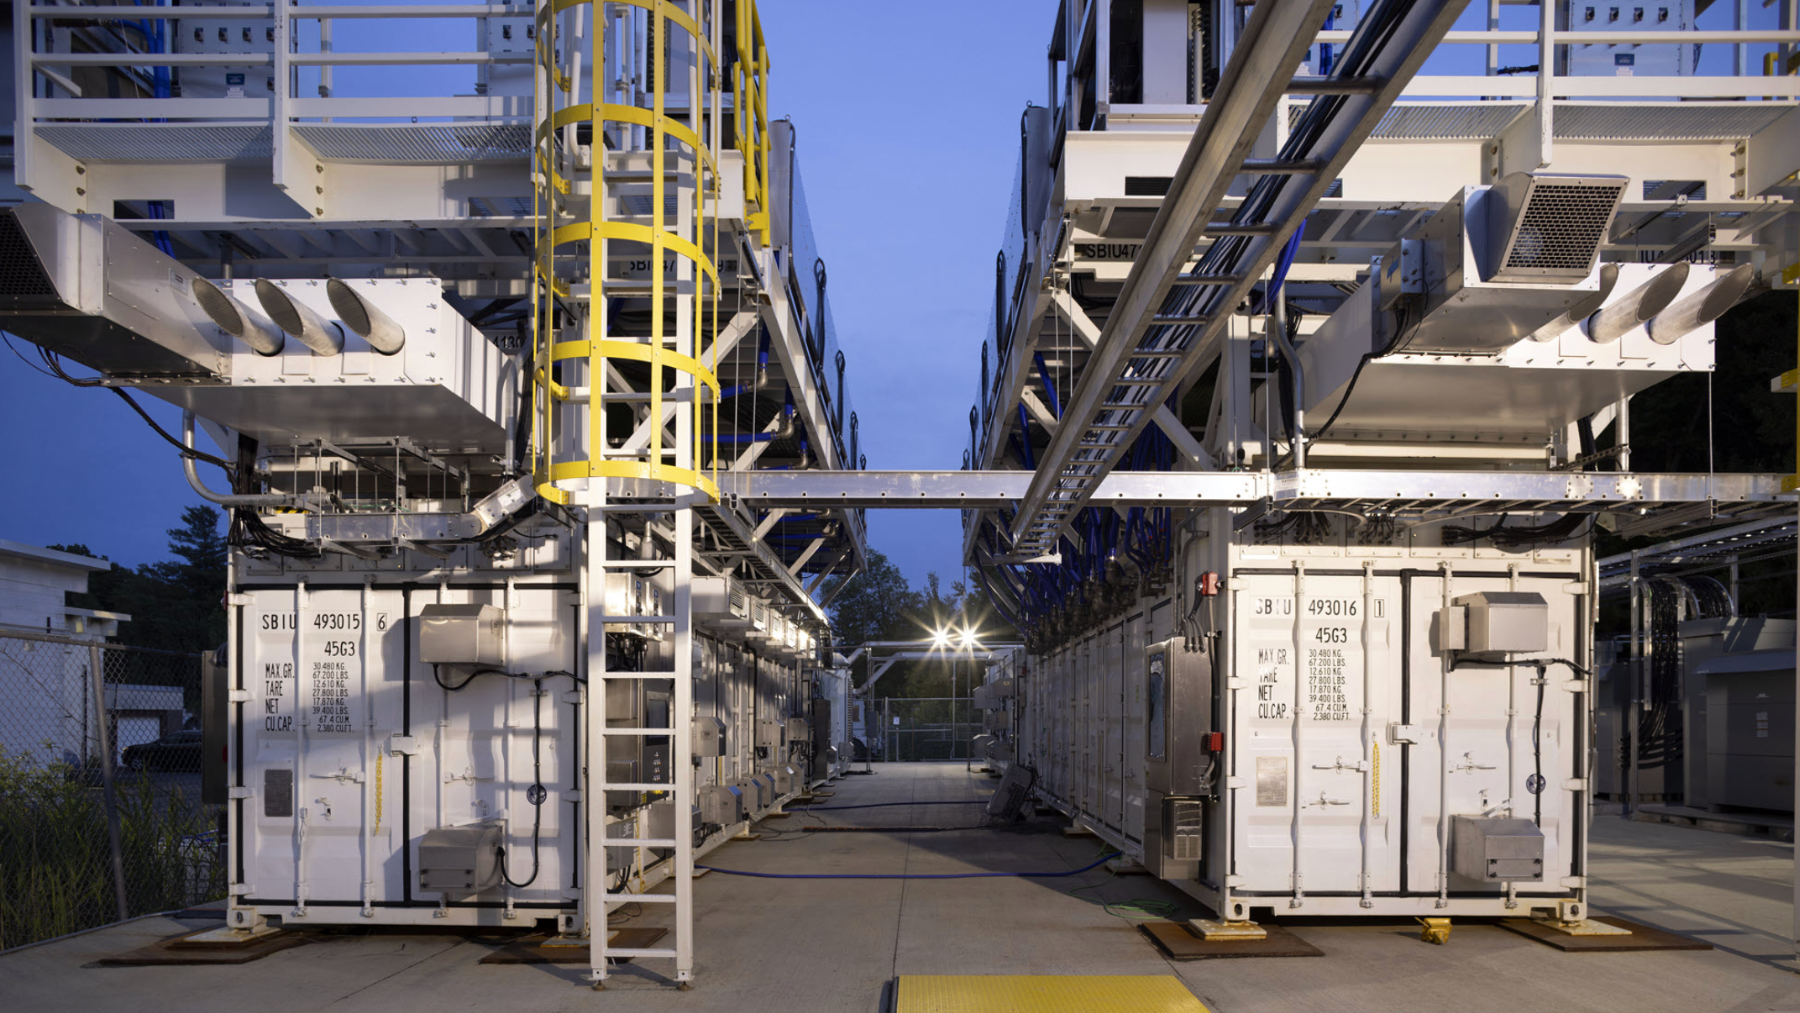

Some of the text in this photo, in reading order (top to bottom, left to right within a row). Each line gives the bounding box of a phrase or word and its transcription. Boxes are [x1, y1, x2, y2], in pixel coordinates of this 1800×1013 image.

[1255, 598, 1291, 615] SBIU
[1308, 599, 1357, 616] 493016
[262, 613, 386, 630] SBIU 493015 6
[1315, 627, 1347, 643] 45G3
[324, 640, 355, 656] 45G3
[265, 680, 283, 696] TARE
[1258, 685, 1273, 700] NET
[265, 698, 279, 714] NET
